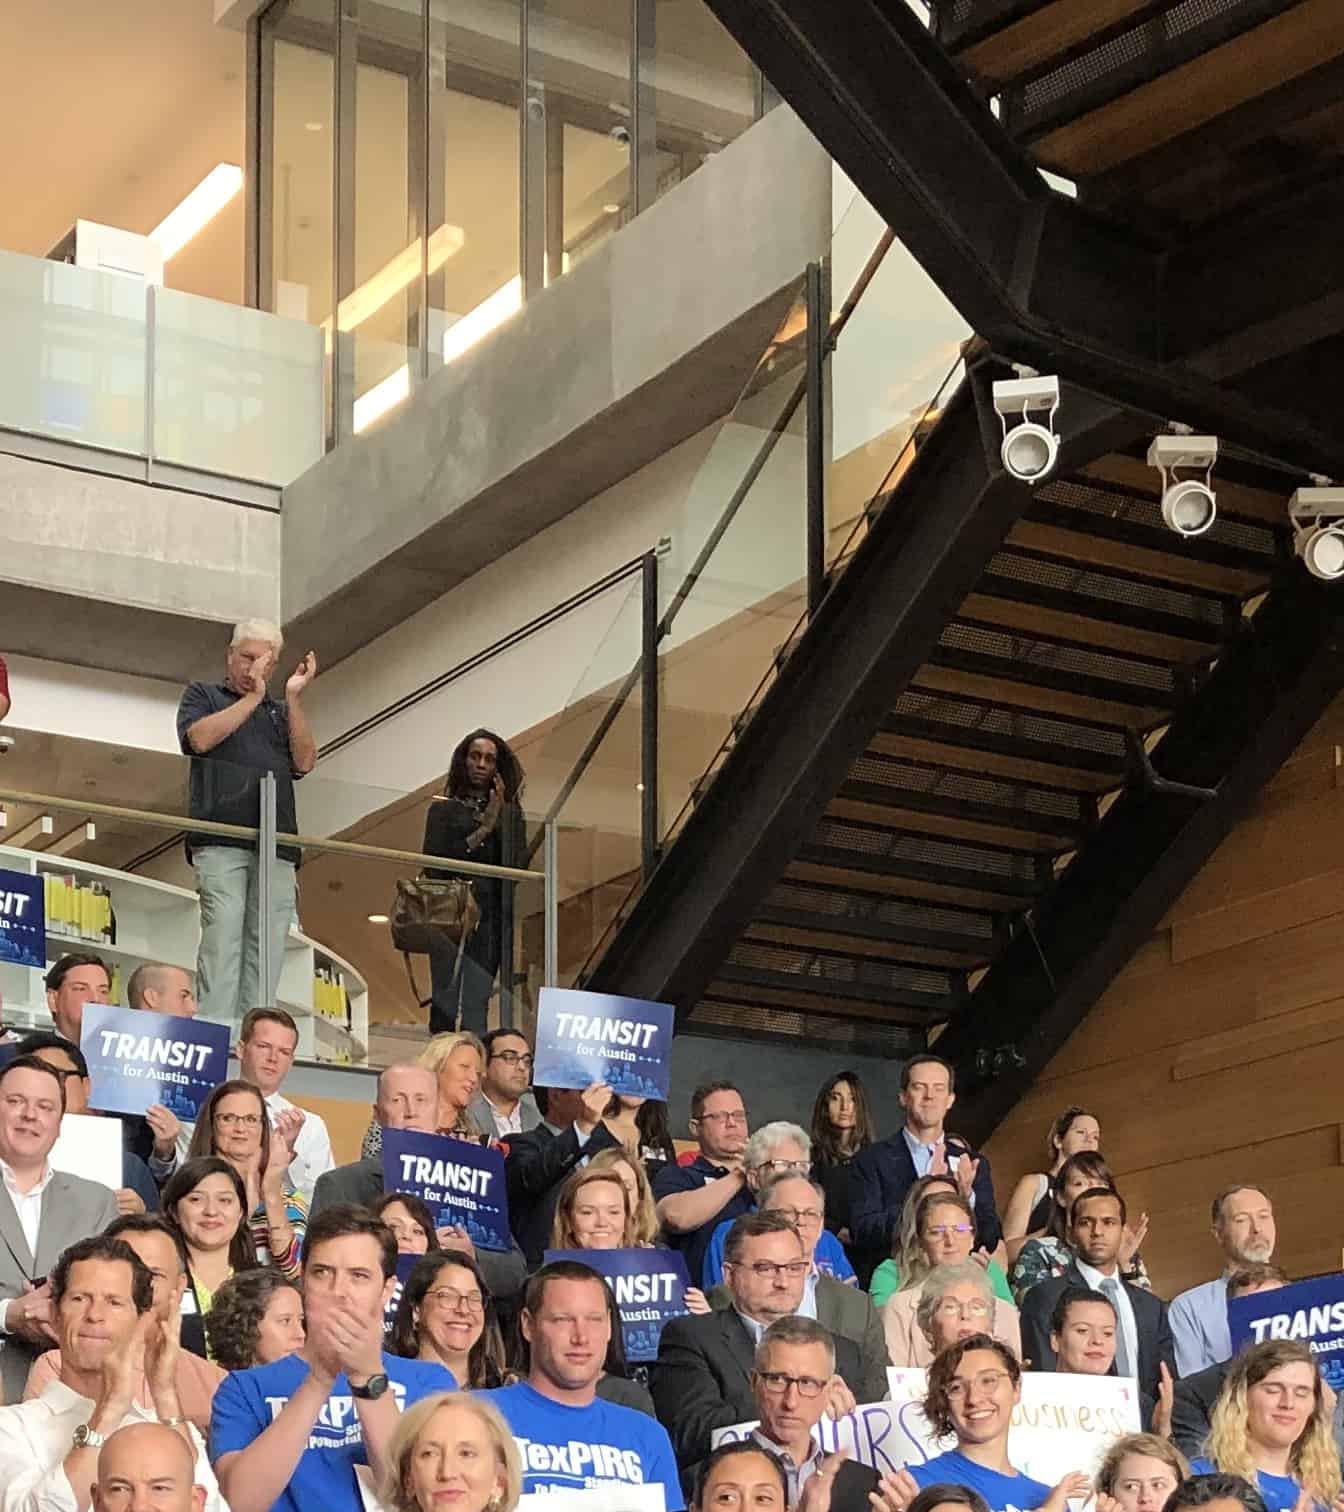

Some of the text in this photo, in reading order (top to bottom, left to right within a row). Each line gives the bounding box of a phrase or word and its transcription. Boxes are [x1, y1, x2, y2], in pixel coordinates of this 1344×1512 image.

[556, 1013, 658, 1048] TRANSIT
[100, 1030, 212, 1071] TRANSIT
[577, 1042, 636, 1062] for Austin
[123, 1064, 189, 1085] for Austin
[399, 1154, 493, 1197] TRANSIT
[424, 1187, 477, 1211] for Austin
[513, 1436, 643, 1485] TexPIRG
